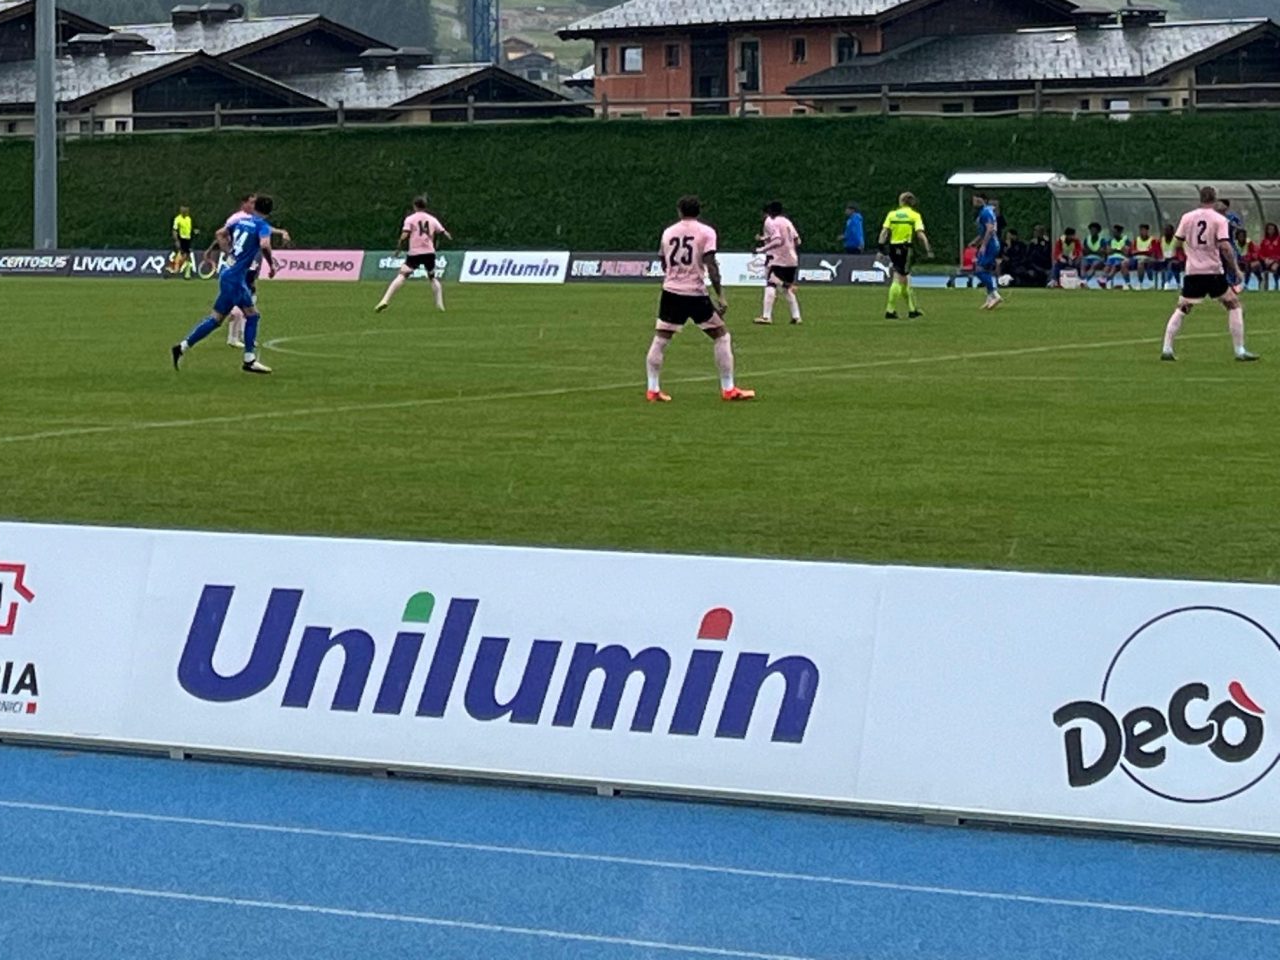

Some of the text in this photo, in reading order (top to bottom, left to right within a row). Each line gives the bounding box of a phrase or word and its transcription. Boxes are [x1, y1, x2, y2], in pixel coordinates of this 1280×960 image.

[1196, 220, 1207, 245] 2
[669, 235, 695, 266] 25
[73, 256, 137, 272] LIVIGNO
[289, 260, 354, 272] PALERMO
[468, 257, 560, 277] Unilumin
[178, 584, 821, 743] Unilumin
